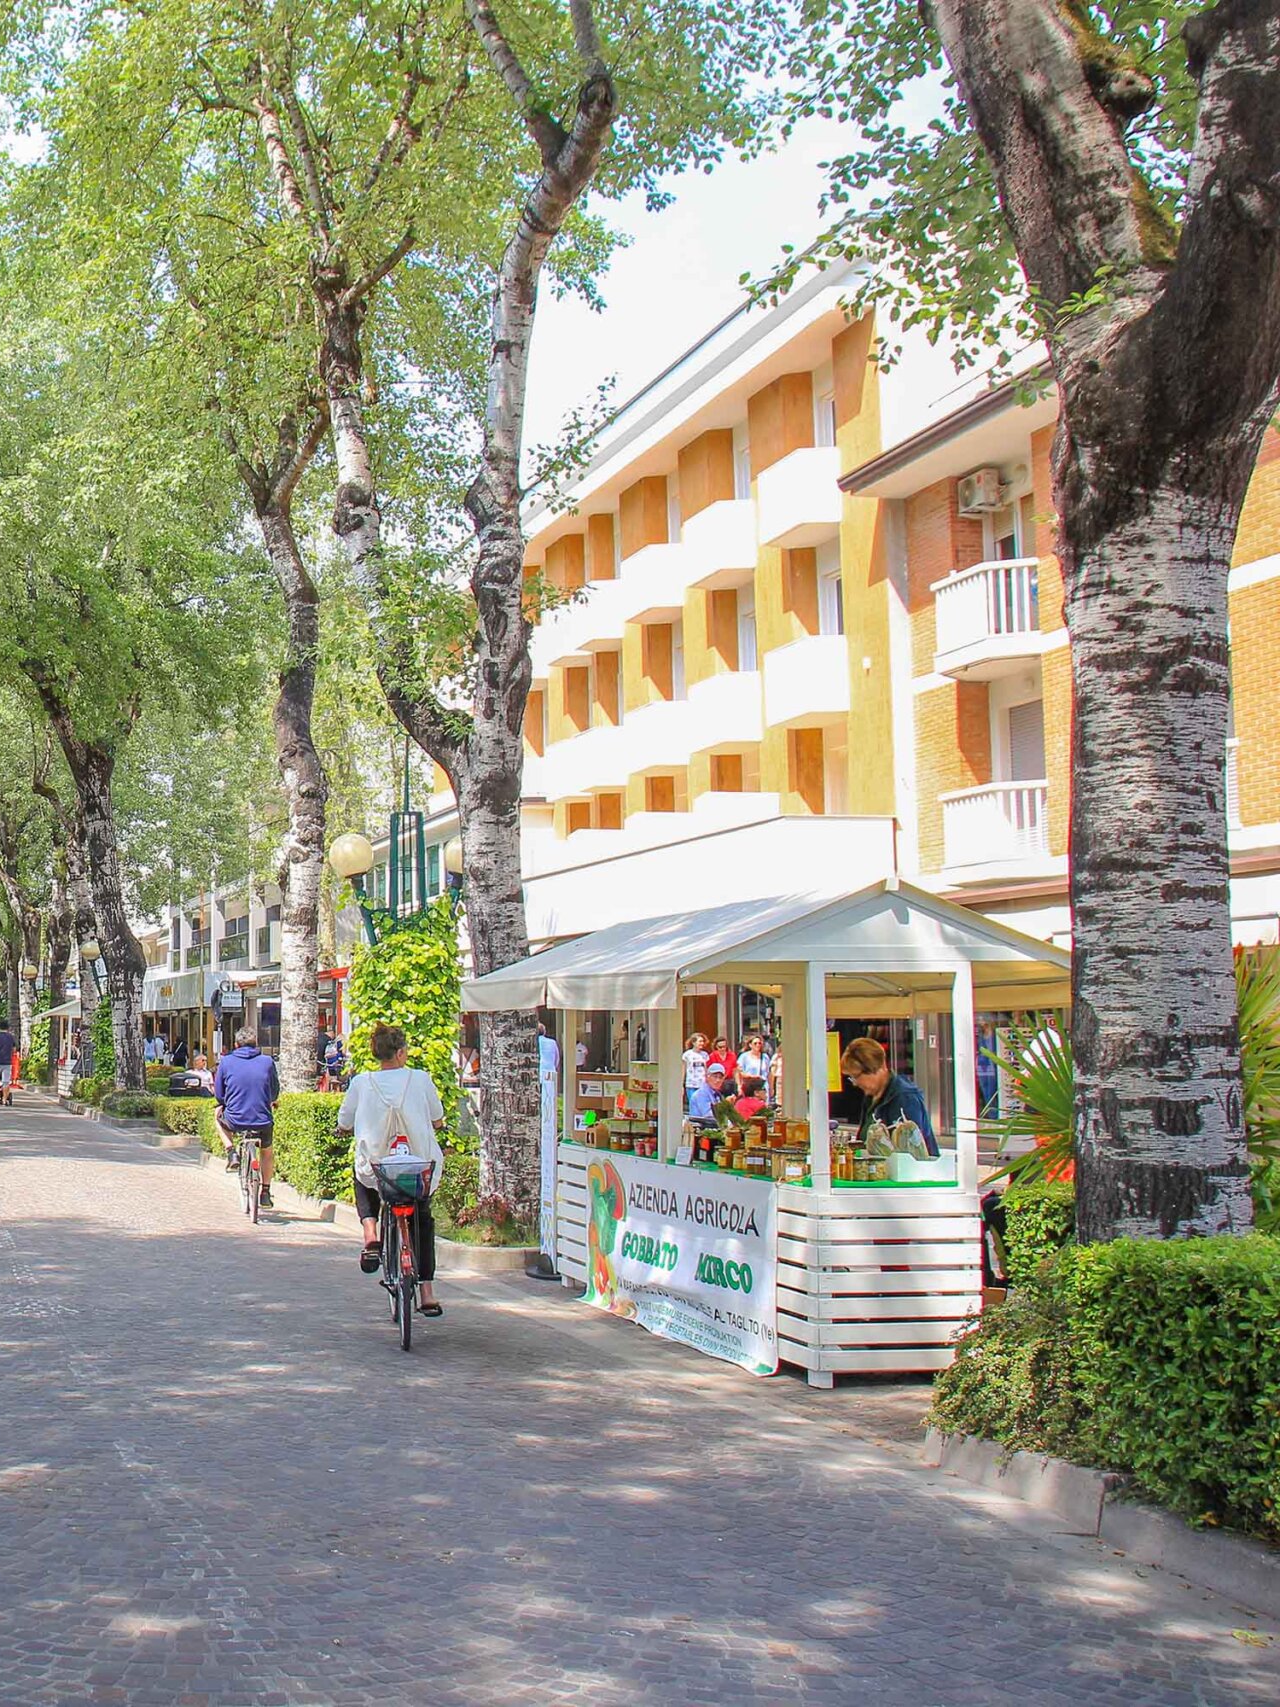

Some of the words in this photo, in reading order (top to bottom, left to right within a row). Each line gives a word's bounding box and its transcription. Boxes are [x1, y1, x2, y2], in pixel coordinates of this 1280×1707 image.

[628, 1182, 679, 1219] AZIENDA
[684, 1194, 761, 1238] AGRICOLA
[621, 1231, 679, 1272] GOBBATO
[694, 1252, 753, 1295] MIRCO
